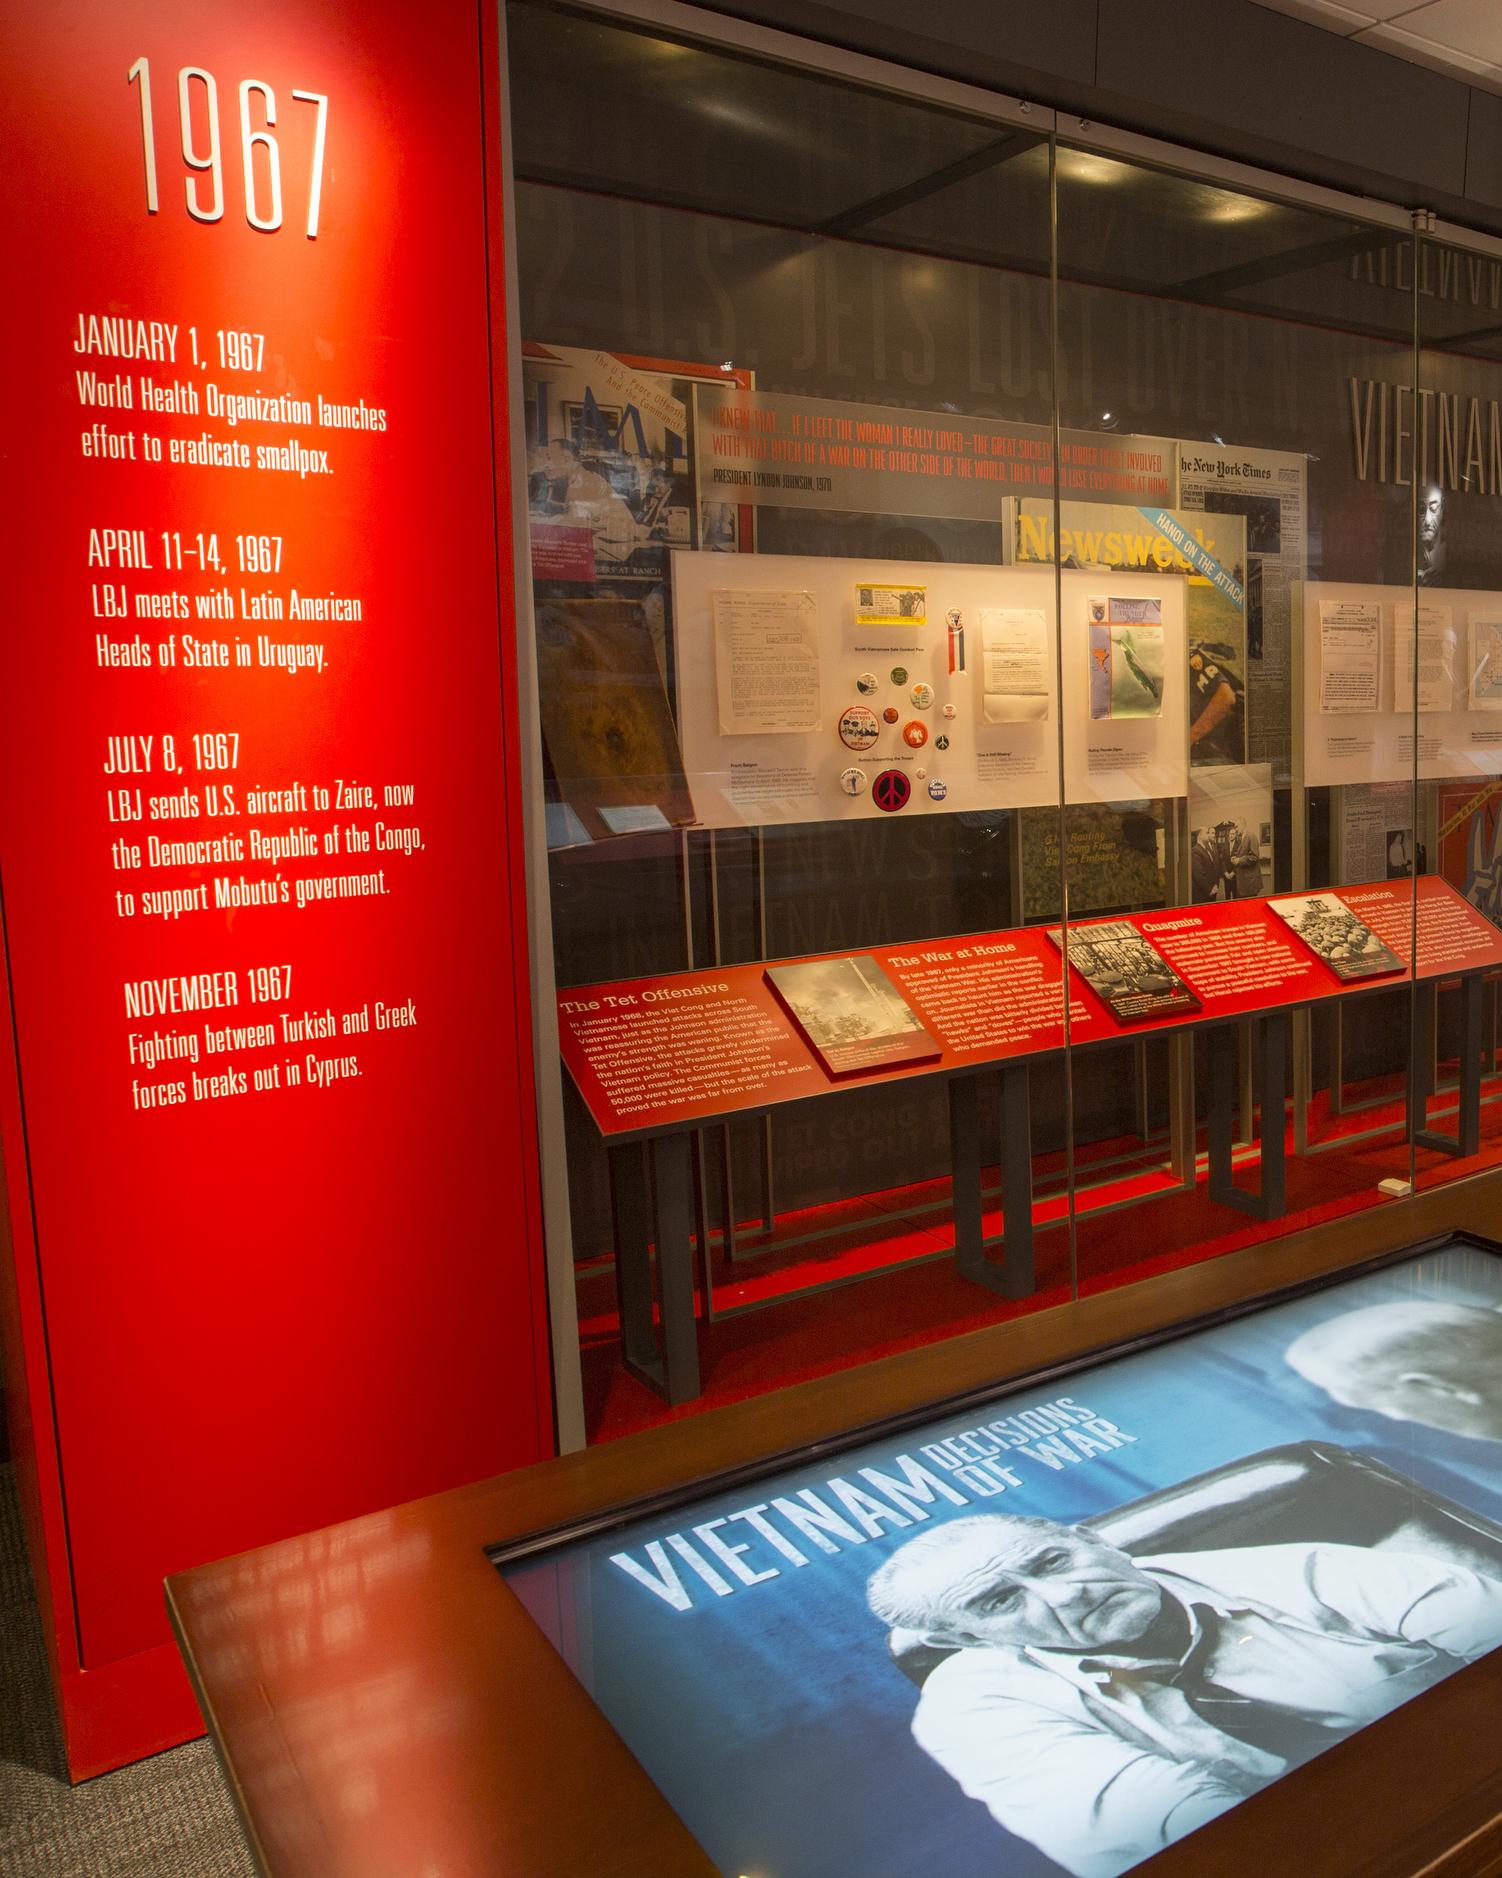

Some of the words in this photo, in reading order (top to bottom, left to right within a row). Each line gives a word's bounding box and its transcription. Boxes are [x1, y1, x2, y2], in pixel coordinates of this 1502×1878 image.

[128, 57, 329, 240] 1967
[74, 313, 178, 363] JANUARY
[189, 326, 206, 370] 1,
[216, 329, 264, 372] 1967
[76, 370, 133, 409] World
[140, 376, 199, 415] Health
[206, 383, 312, 425] Organization
[317, 394, 386, 432] launches
[82, 424, 136, 460] effort
[142, 432, 162, 462] to
[169, 435, 250, 468] eradicate
[256, 443, 333, 479] smallpox.
[712, 434, 740, 458] WITH
[804, 443, 815, 465] OF
[829, 446, 849, 468] WAR
[852, 448, 866, 469] ON
[869, 450, 885, 471] THE
[889, 452, 917, 473] OTHER
[921, 455, 940, 475] SIDE
[944, 457, 953, 477] OF
[957, 458, 972, 478] THE
[1038, 466, 1066, 486] WOUD
[1070, 470, 1087, 488] LOSE
[1148, 477, 1168, 495] HOME
[811, 418, 832, 440] LEFT
[837, 421, 852, 442] THE
[857, 423, 893, 446] WOMAN
[903, 428, 933, 450] REALLY
[991, 437, 1016, 458] GREAT
[1127, 452, 1162, 472] INVOLVED
[1181, 457, 1192, 472] he
[1193, 458, 1215, 473] New
[1216, 460, 1241, 479] York
[1242, 463, 1272, 480] Times
[712, 467, 751, 486] PRESIDENT
[753, 471, 780, 488] LYNDON
[782, 474, 814, 491] JOHNSON,
[816, 476, 832, 492] 1970
[88, 528, 152, 569] APRIL
[236, 534, 282, 573] 1967
[1156, 512, 1185, 545] HANOI
[1183, 540, 1198, 559] ON
[1198, 552, 1216, 576] THE
[1213, 571, 1245, 605] ATTACK
[92, 584, 127, 617] LBJ
[135, 591, 189, 618] meets
[195, 587, 234, 619] with
[240, 588, 283, 620] Latin
[289, 590, 361, 621] American
[96, 633, 151, 667] Heads
[158, 634, 175, 666] of
[182, 634, 229, 667] State
[235, 636, 251, 666] in
[257, 636, 328, 674] Uruguay.
[104, 735, 153, 774] JULY
[163, 734, 183, 774] 8,
[192, 732, 239, 770] 1967
[107, 788, 142, 822] LBJ
[149, 786, 200, 820] sends
[205, 784, 240, 816] U.S.
[247, 781, 307, 814] aircraft
[312, 785, 329, 811] to
[335, 779, 377, 810] Zaire,
[384, 784, 414, 806] now
[112, 837, 141, 870] the
[148, 832, 244, 867] Democratic
[249, 826, 318, 865] Republic
[324, 824, 339, 854] of
[345, 823, 370, 853] the
[375, 821, 425, 856] Congo,
[1046, 857, 1078, 866] Saion
[116, 890, 135, 917] to
[142, 883, 208, 920] support
[295, 869, 390, 908] government.
[1342, 891, 1394, 904] Escalation
[1142, 918, 1202, 932] Quagmire
[888, 956, 920, 969] The
[921, 950, 953, 964] War
[956, 949, 971, 960] at
[972, 943, 1017, 957] Home
[124, 971, 238, 1018] NOVEMBER
[247, 964, 291, 1003] 1967
[559, 1001, 600, 1013] The
[603, 994, 638, 1007] Tet
[641, 983, 729, 1002] Offensive
[582, 1016, 617, 1026] January
[620, 1012, 644, 1020] 1968,
[680, 1004, 704, 1012] Cong
[722, 998, 747, 1008] North
[128, 1029, 199, 1068] Fighting
[205, 1024, 275, 1054] between
[279, 1008, 336, 1043] Turkish
[342, 1003, 368, 1035] and
[375, 998, 416, 1030] Greek
[132, 1079, 186, 1110] forces
[192, 1067, 247, 1101] breaks
[254, 1063, 280, 1091] out
[286, 1060, 300, 1086] in
[306, 1055, 362, 1088] Cyprus.
[919, 1397, 1098, 1471] DECISIONS
[951, 1449, 1025, 1498] OF
[1017, 1418, 1138, 1472] WAR
[609, 1455, 970, 1612] VIETNAM
